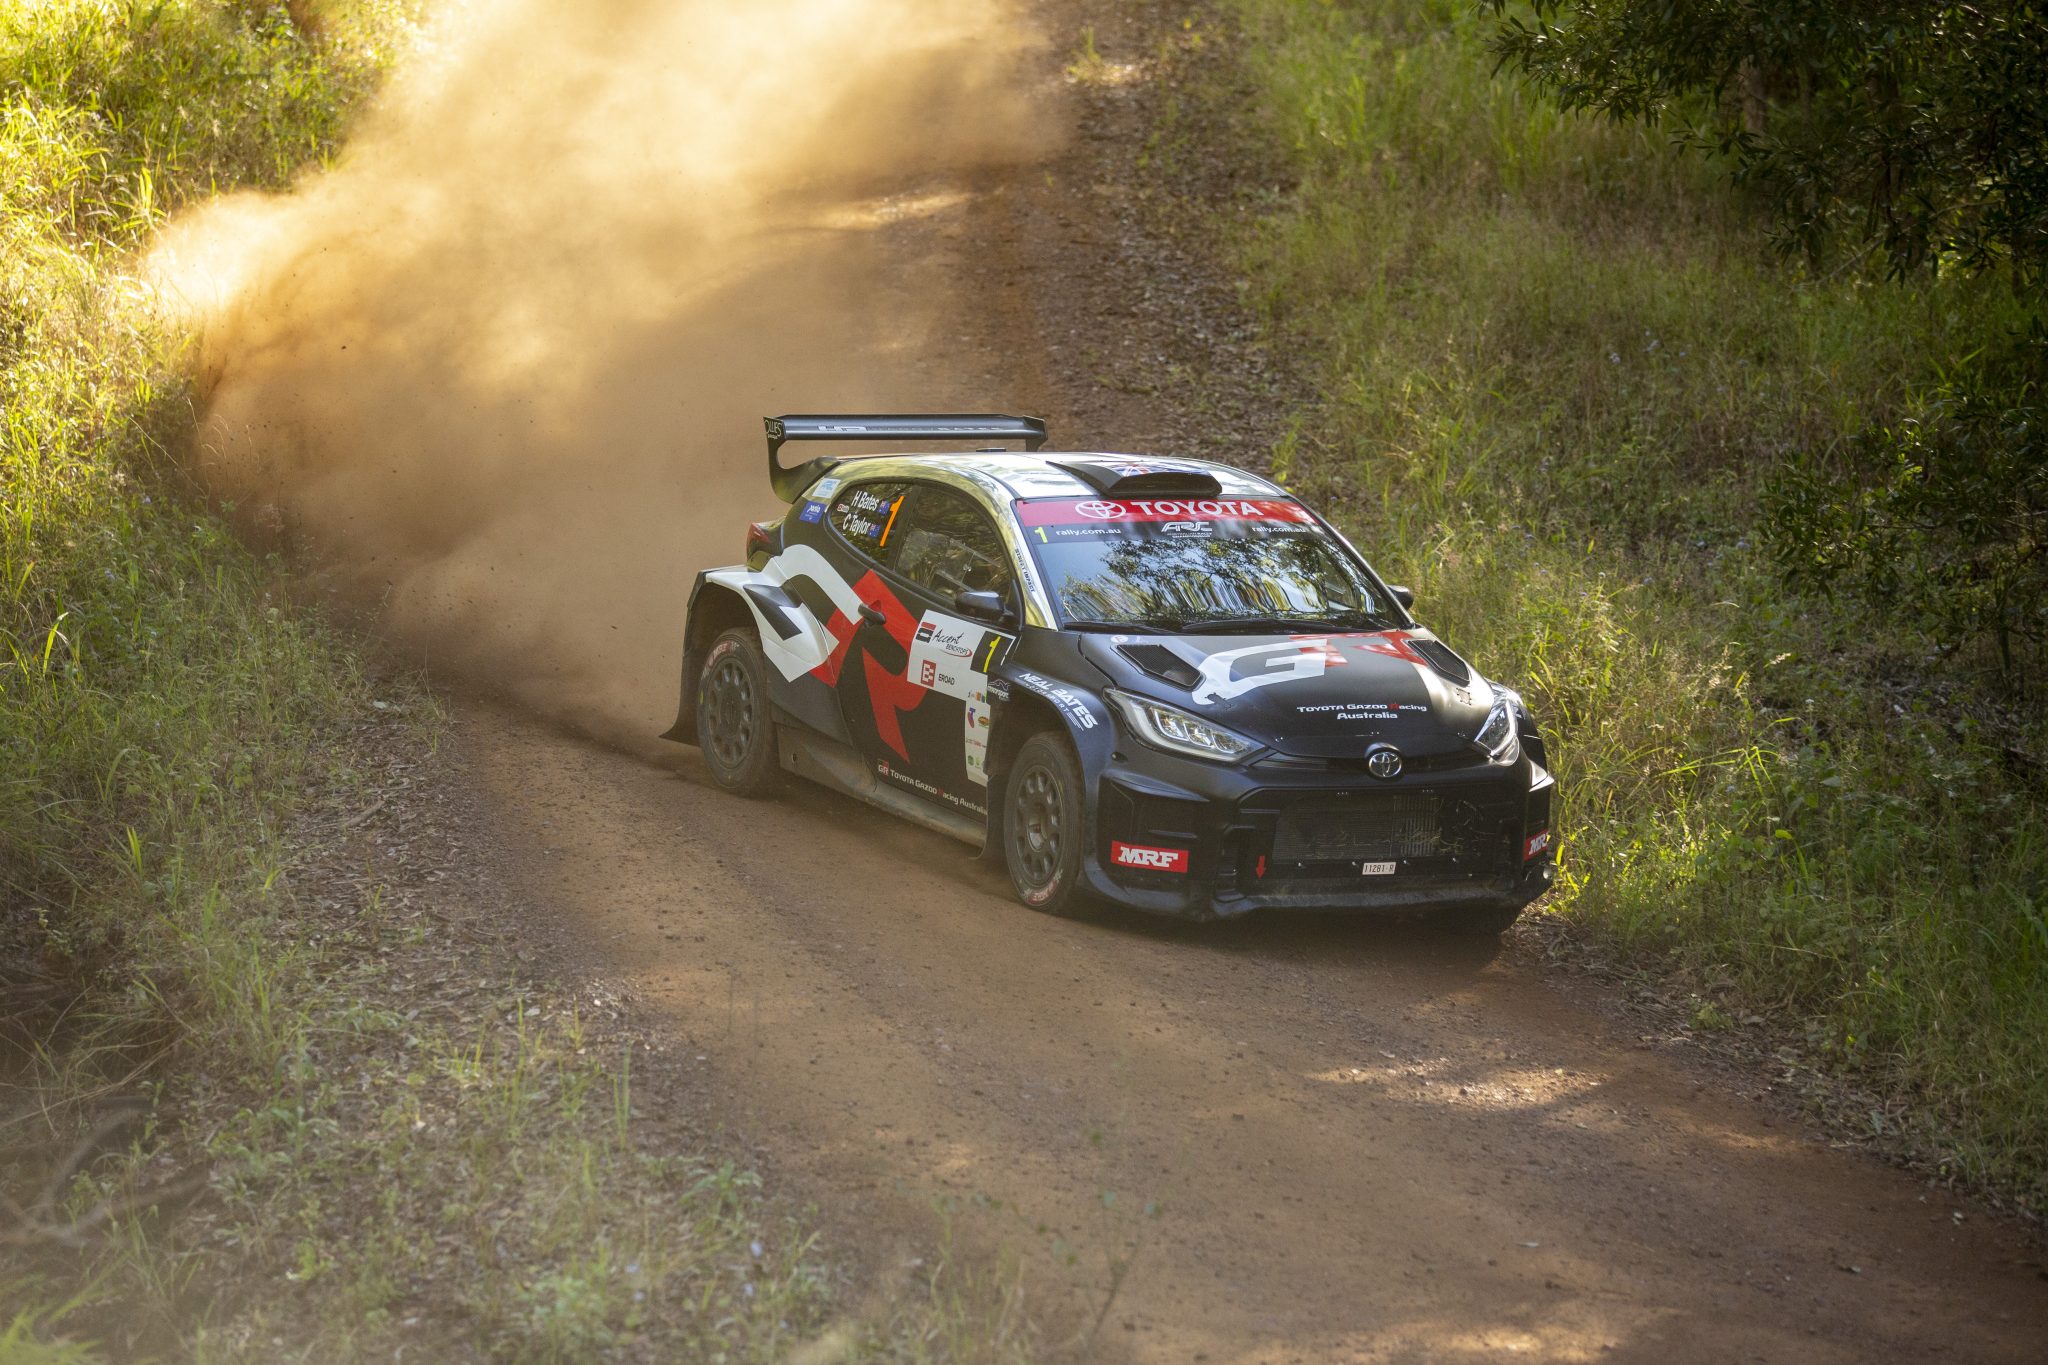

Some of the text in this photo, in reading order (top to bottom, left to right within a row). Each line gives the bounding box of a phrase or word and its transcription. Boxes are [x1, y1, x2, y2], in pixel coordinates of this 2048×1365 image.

[851, 490, 861, 507] H
[858, 491, 880, 512] Bates
[1130, 500, 1265, 516] TOYOTA
[842, 513, 872, 537] C Taylor
[880, 495, 905, 547] 1
[1033, 526, 1048, 544] 1
[1055, 528, 1122, 537] rally.com.au
[931, 628, 965, 645] Accent
[983, 635, 1001, 673] 1
[938, 673, 955, 686] EROAD
[1019, 673, 1099, 729] NEAL BATES
[1296, 705, 1345, 713] TOYOTA
[1388, 703, 1428, 712] Racing
[1336, 711, 1398, 720] Australia
[890, 769, 914, 785] TOYOTA
[959, 798, 988, 816] Australia
[1118, 846, 1179, 868] MRF
